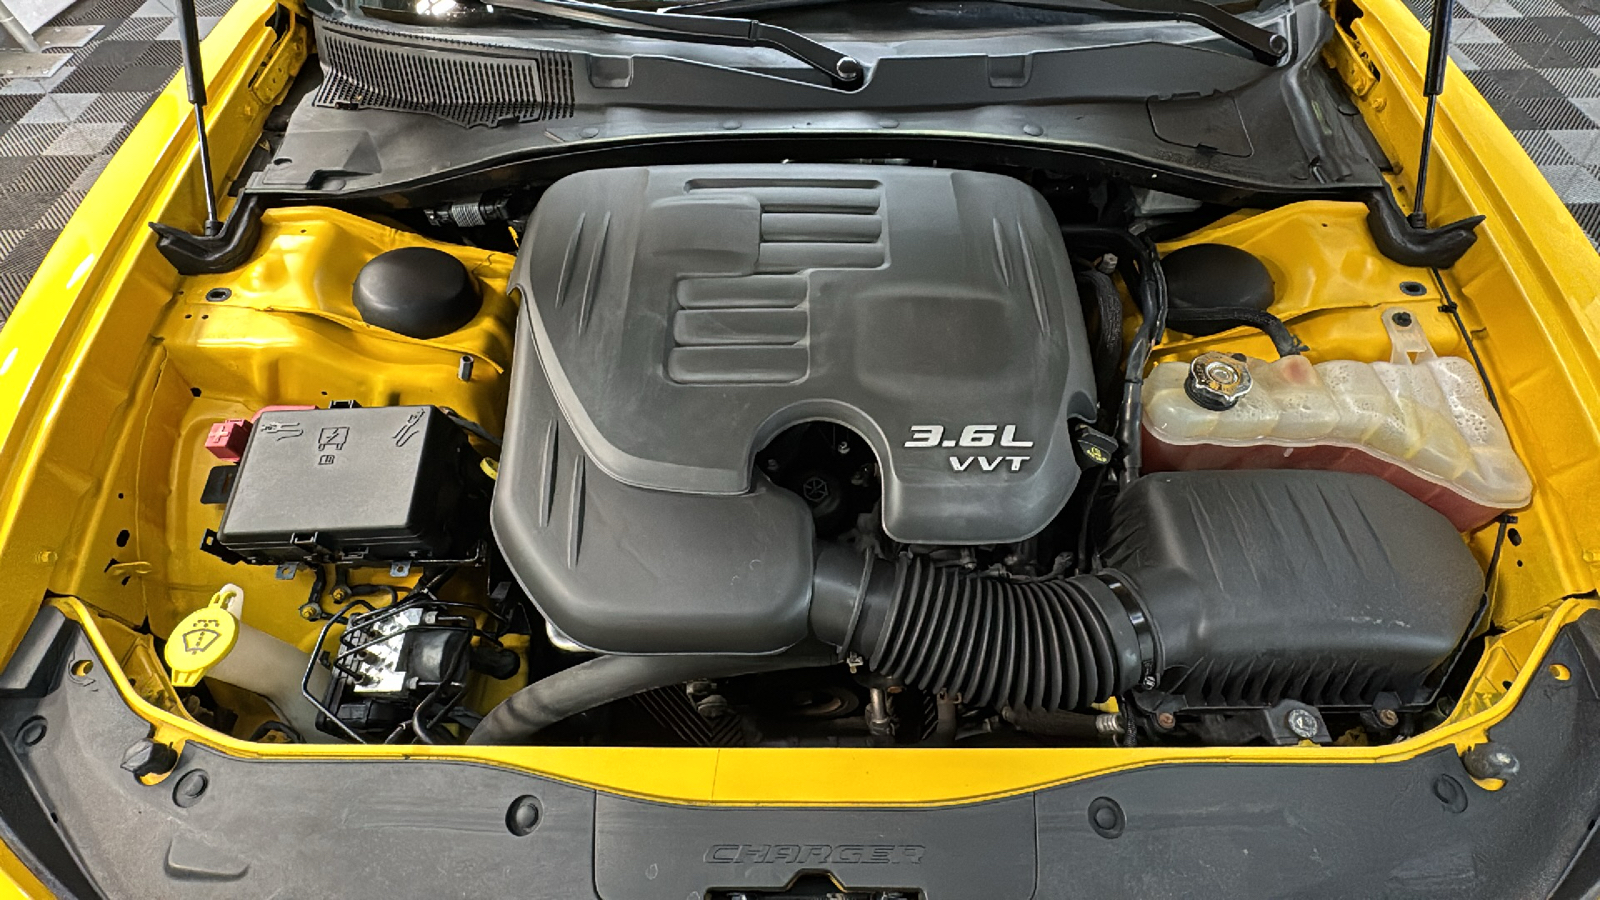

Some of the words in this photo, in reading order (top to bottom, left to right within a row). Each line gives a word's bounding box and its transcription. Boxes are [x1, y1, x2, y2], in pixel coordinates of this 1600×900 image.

[904, 424, 1034, 448] 3.6L
[949, 456, 1031, 471] VVT
[703, 844, 926, 865] CHARGER
